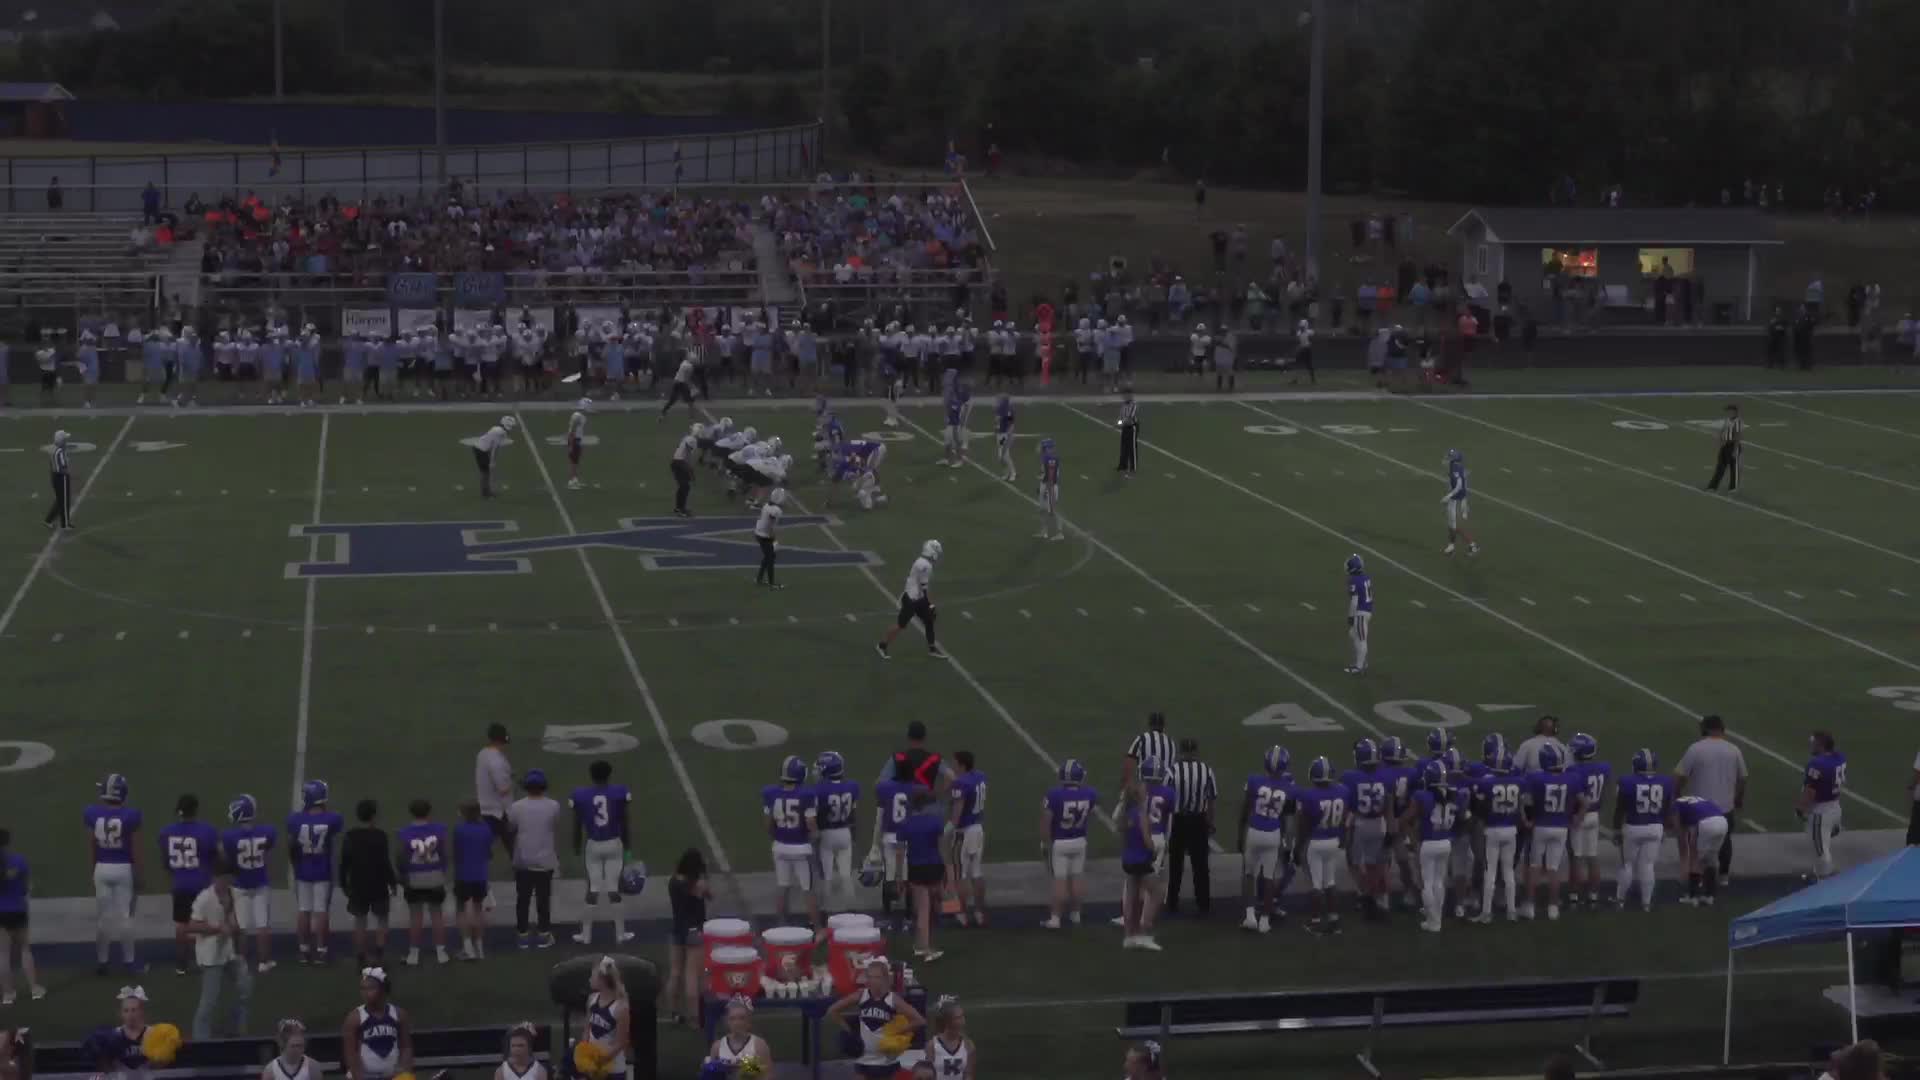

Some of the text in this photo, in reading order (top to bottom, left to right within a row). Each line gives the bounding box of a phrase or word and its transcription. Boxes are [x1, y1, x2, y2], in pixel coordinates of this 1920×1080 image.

[1240, 699, 1473, 732] 40
[541, 718, 790, 755] 50
[593, 794, 610, 827] 3
[772, 797, 801, 829] 45
[1060, 799, 1091, 830] 57
[1491, 783, 1520, 816] 29
[1544, 783, 1568, 814] 51
[1635, 783, 1664, 815] 59
[94, 816, 123, 849] 42
[297, 823, 329, 855] 47
[168, 836, 200, 870] 52
[236, 836, 267, 870] 25
[943, 1057, 962, 1076] K
